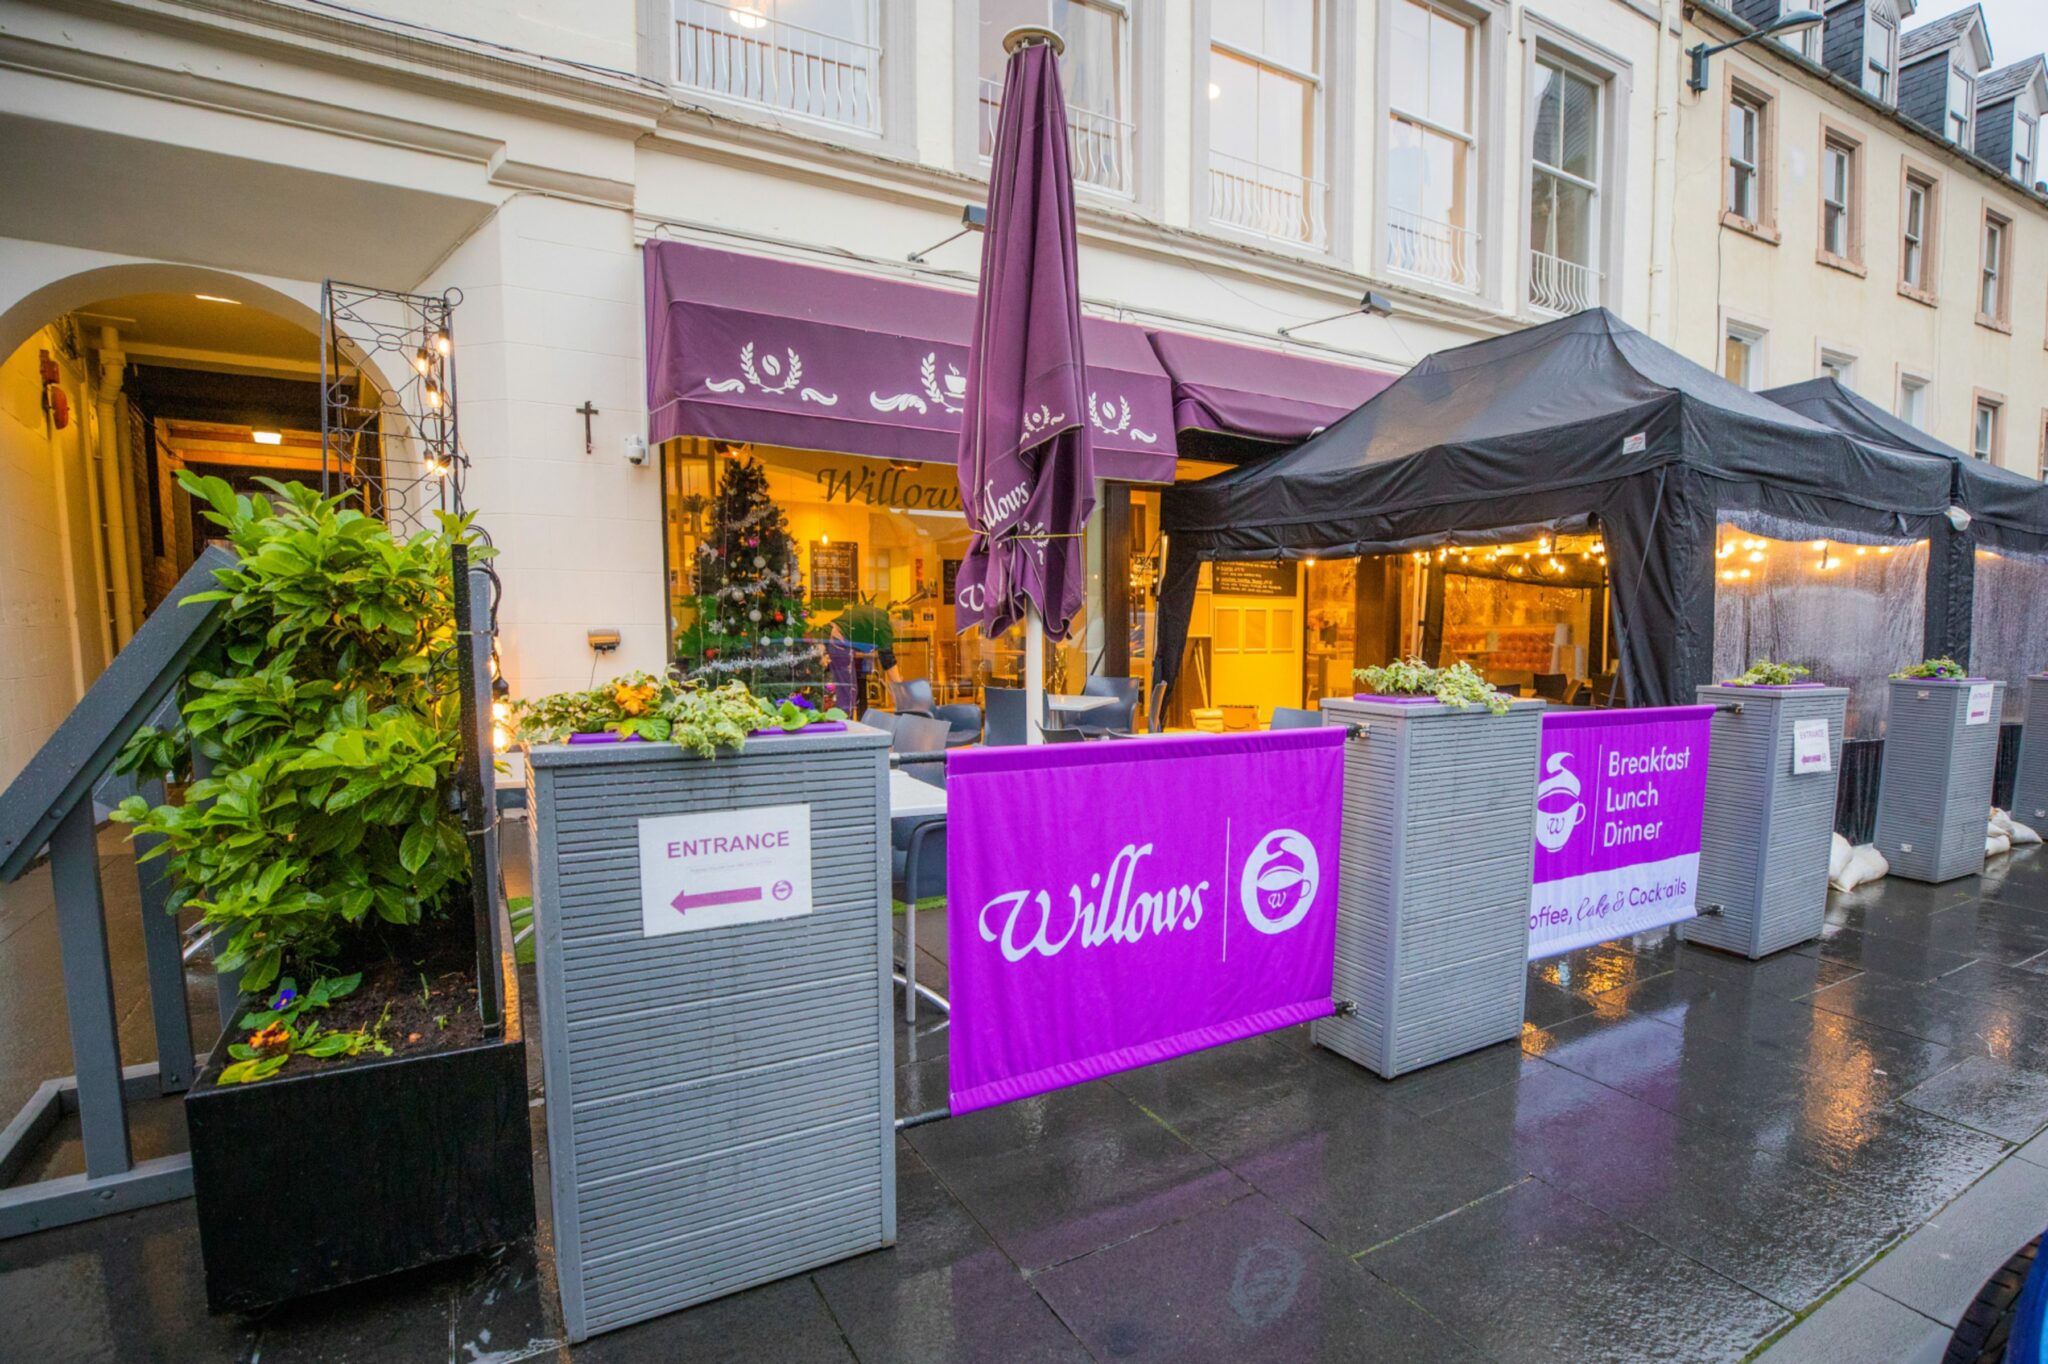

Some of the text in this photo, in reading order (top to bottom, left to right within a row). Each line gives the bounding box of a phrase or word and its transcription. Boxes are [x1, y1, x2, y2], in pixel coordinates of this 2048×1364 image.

[1608, 746, 1690, 777] Breakfast
[1606, 781, 1659, 813] Lunch
[667, 830, 790, 859] ENTRANCE
[1603, 820, 1662, 848] Dinner
[978, 842, 1210, 962] Willows
[1529, 905, 1573, 931] offee,
[1577, 893, 1611, 920] Cake
[1612, 890, 1625, 912] &
